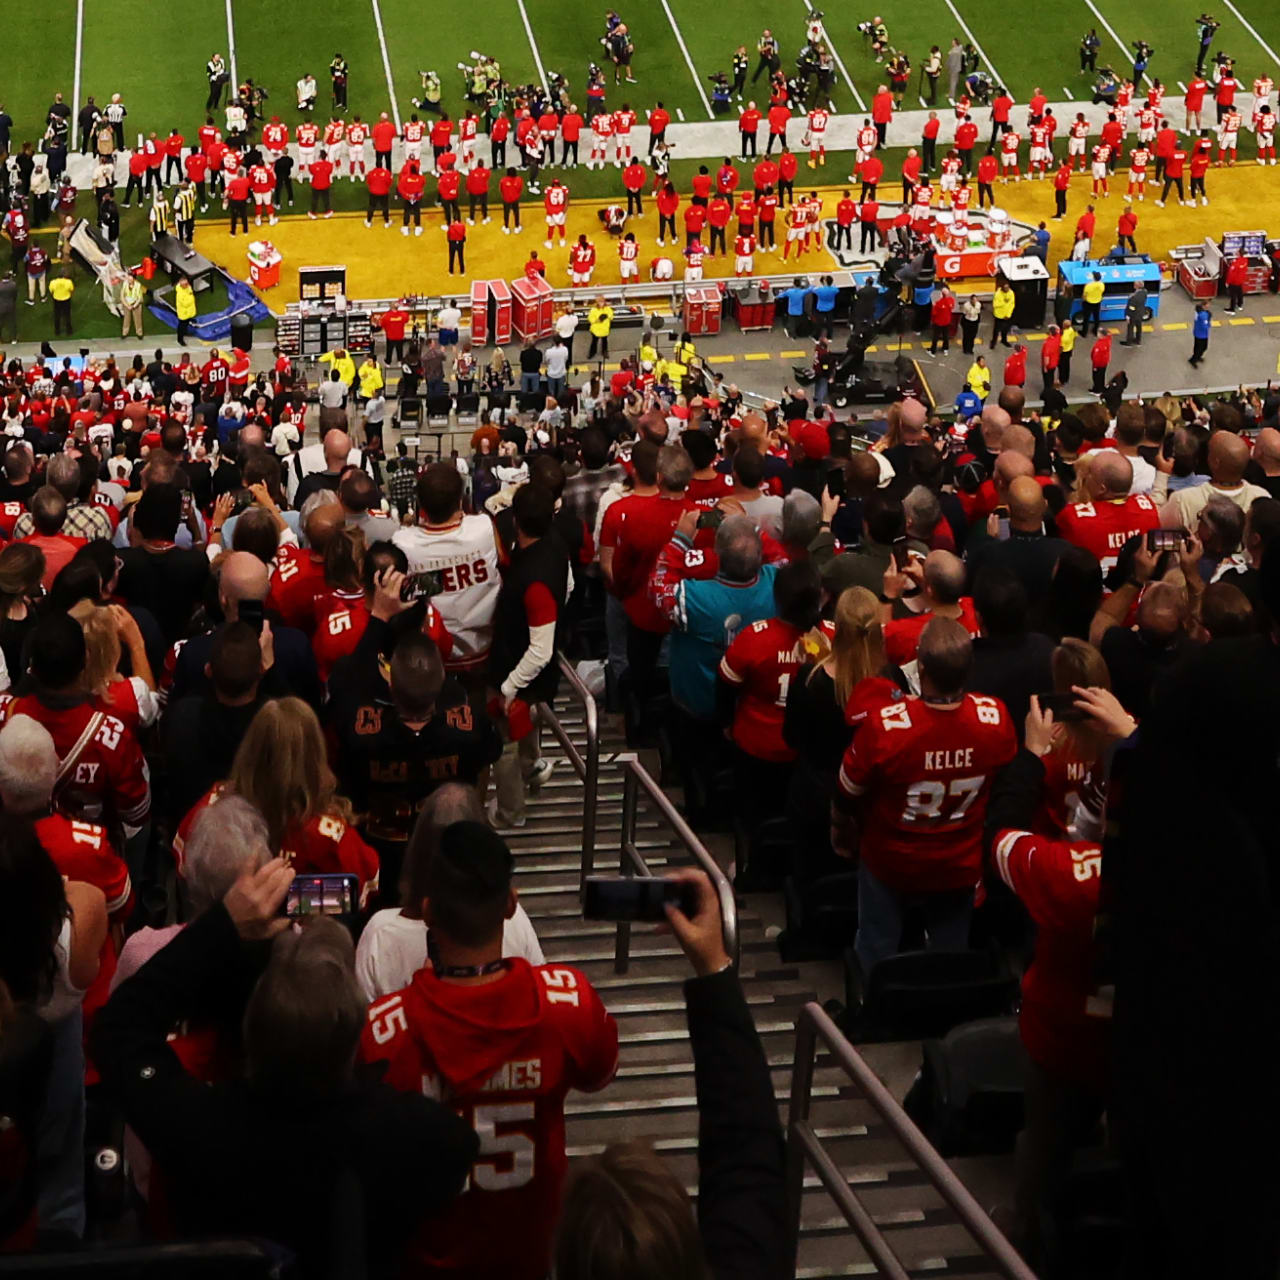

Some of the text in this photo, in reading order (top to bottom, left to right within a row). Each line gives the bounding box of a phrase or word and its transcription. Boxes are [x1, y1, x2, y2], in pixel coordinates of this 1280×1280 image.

[269, 131, 282, 142] 74
[300, 133, 316, 144] 73
[350, 132, 365, 143] 83
[253, 171, 268, 184] 79
[549, 192, 565, 205] 64
[795, 210, 807, 224] 11
[575, 249, 593, 264] 77
[623, 247, 636, 261] 10
[688, 253, 704, 266] 25
[943, 256, 962, 274] G
[249, 266, 260, 282] G
[208, 367, 226, 383] 80
[113, 399, 125, 411] 13
[289, 413, 302, 425] 10
[442, 559, 488, 592] ERS
[328, 611, 353, 636] 15
[751, 619, 768, 633] 15
[879, 701, 912, 731] 87
[95, 714, 125, 751] 23
[924, 748, 973, 771] KELCE
[902, 775, 985, 824] 87
[541, 969, 580, 1008] 15
[369, 996, 410, 1045] 15
[470, 1101, 537, 1191] 5
